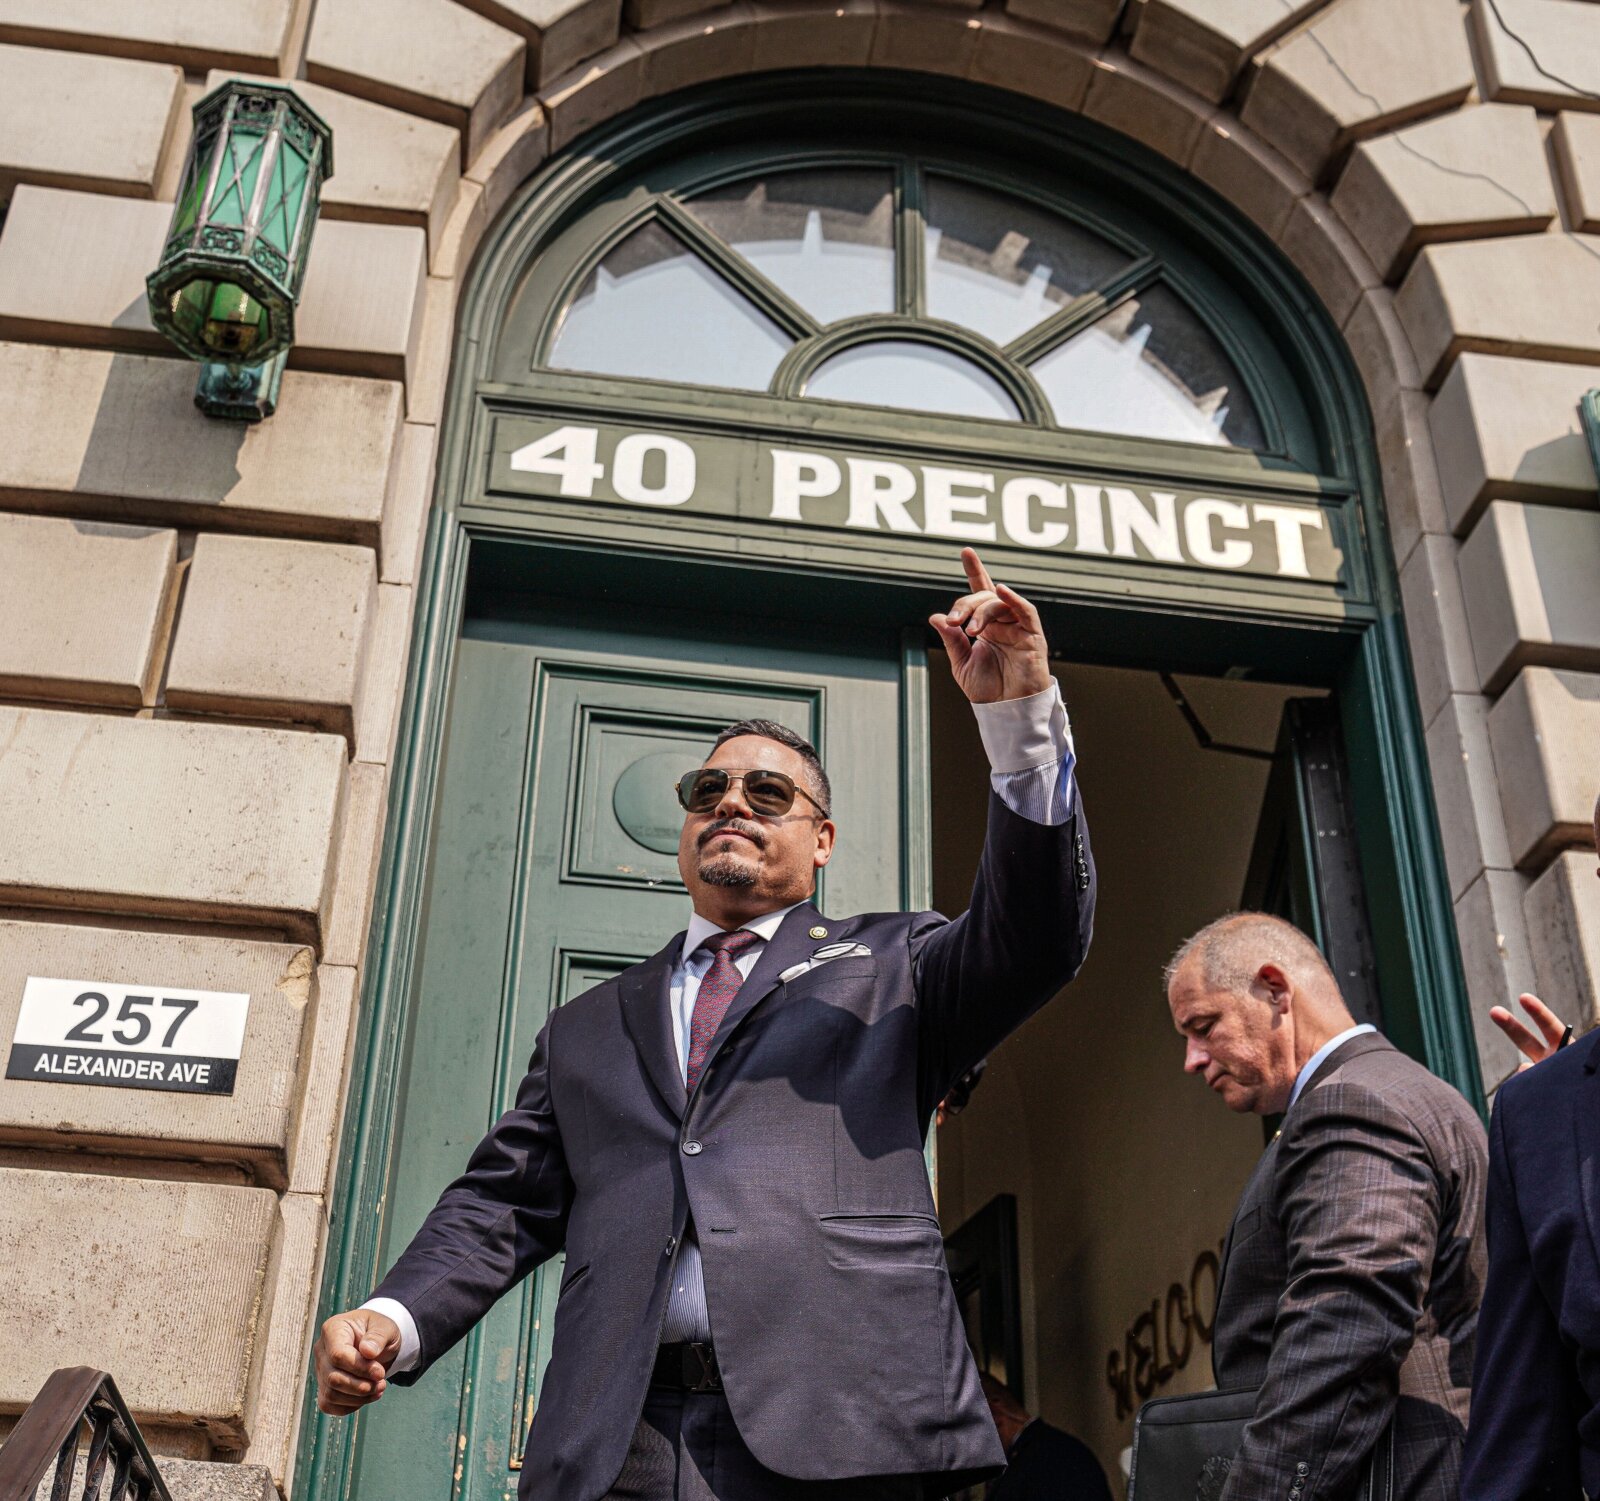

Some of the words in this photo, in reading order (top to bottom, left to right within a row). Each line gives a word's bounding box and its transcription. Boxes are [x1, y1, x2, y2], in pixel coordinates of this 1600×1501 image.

[510, 426, 697, 506] 40
[769, 449, 1323, 578] PRECINCT
[33, 1053, 165, 1081] ALEXANDER
[167, 1062, 211, 1084] AVE
[64, 991, 200, 1048] 257
[1107, 1236, 1226, 1422] WELCO
